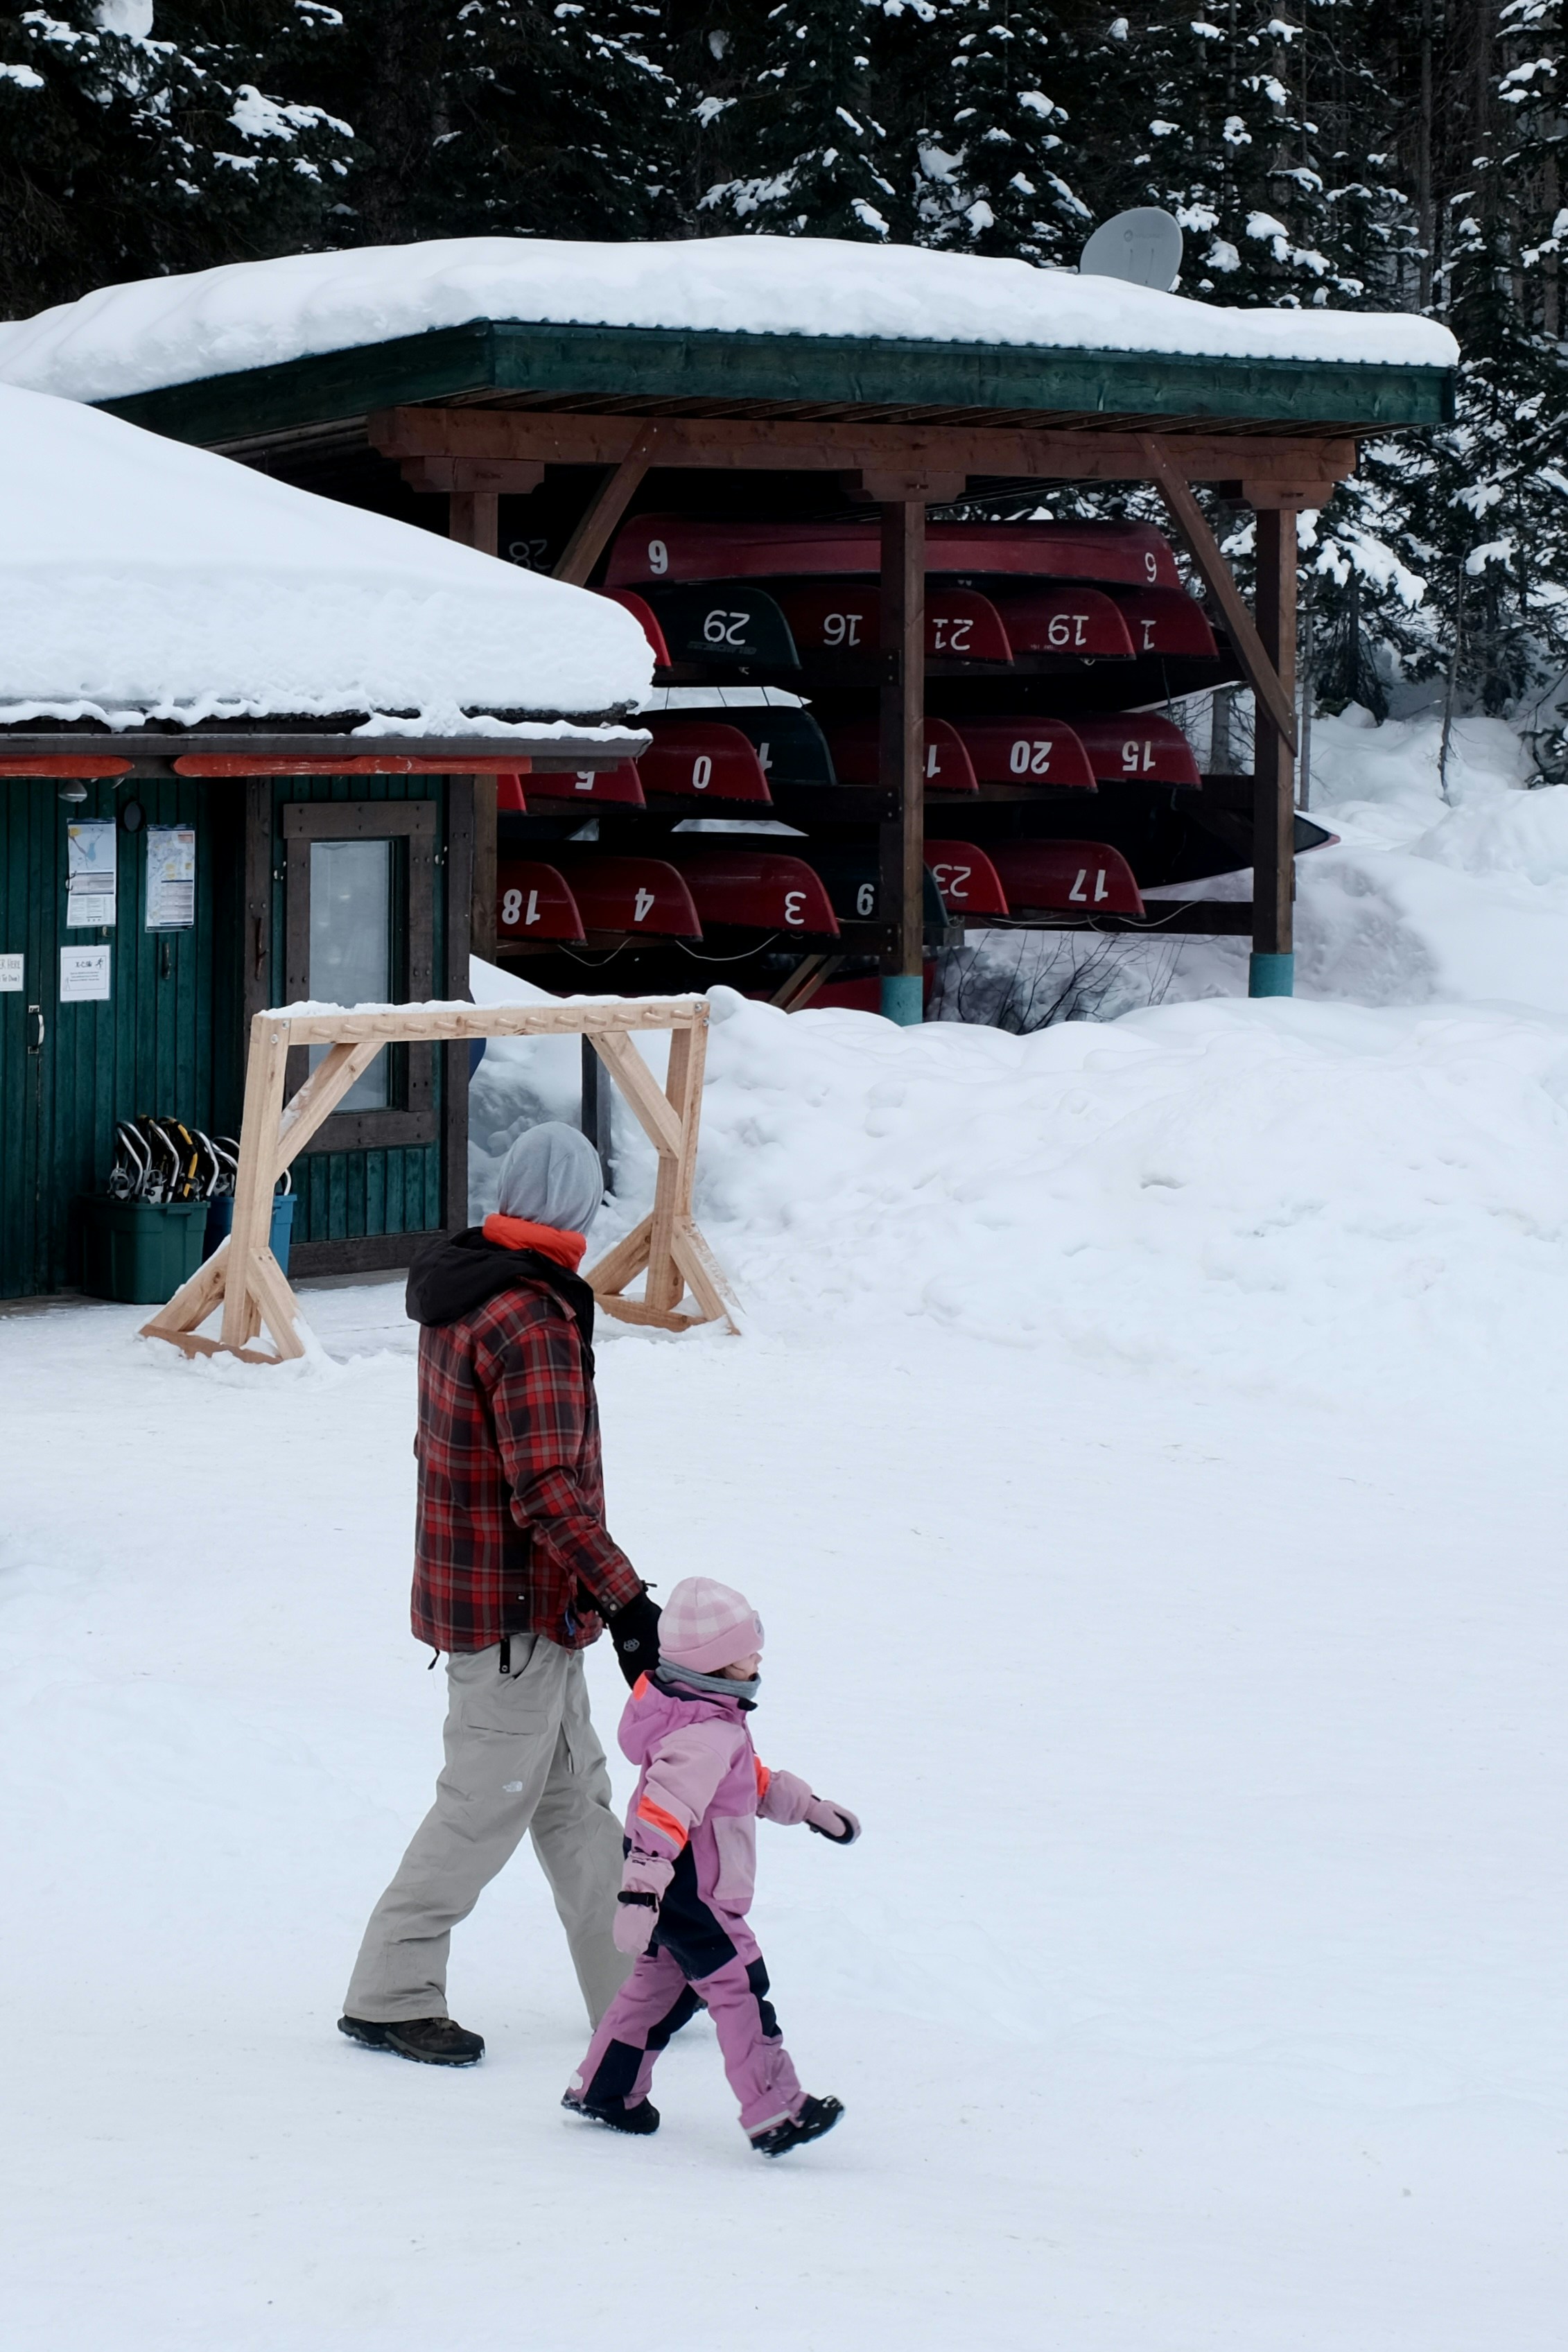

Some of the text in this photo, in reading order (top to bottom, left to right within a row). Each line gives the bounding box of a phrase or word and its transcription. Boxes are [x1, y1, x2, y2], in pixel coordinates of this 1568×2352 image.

[704, 610, 750, 645] 29
[824, 613, 863, 646] 16
[932, 618, 974, 651] 21
[1048, 614, 1089, 646] 19
[1140, 620, 1156, 650] 1
[692, 756, 712, 789] 0
[922, 744, 941, 778] 1
[1010, 741, 1052, 774] 20
[1122, 740, 1156, 772] 15
[575, 772, 595, 790] 5
[932, 864, 971, 897] 23
[1068, 869, 1108, 902] 17
[501, 889, 541, 925] 18
[634, 887, 655, 922] 4
[785, 891, 807, 925] 3
